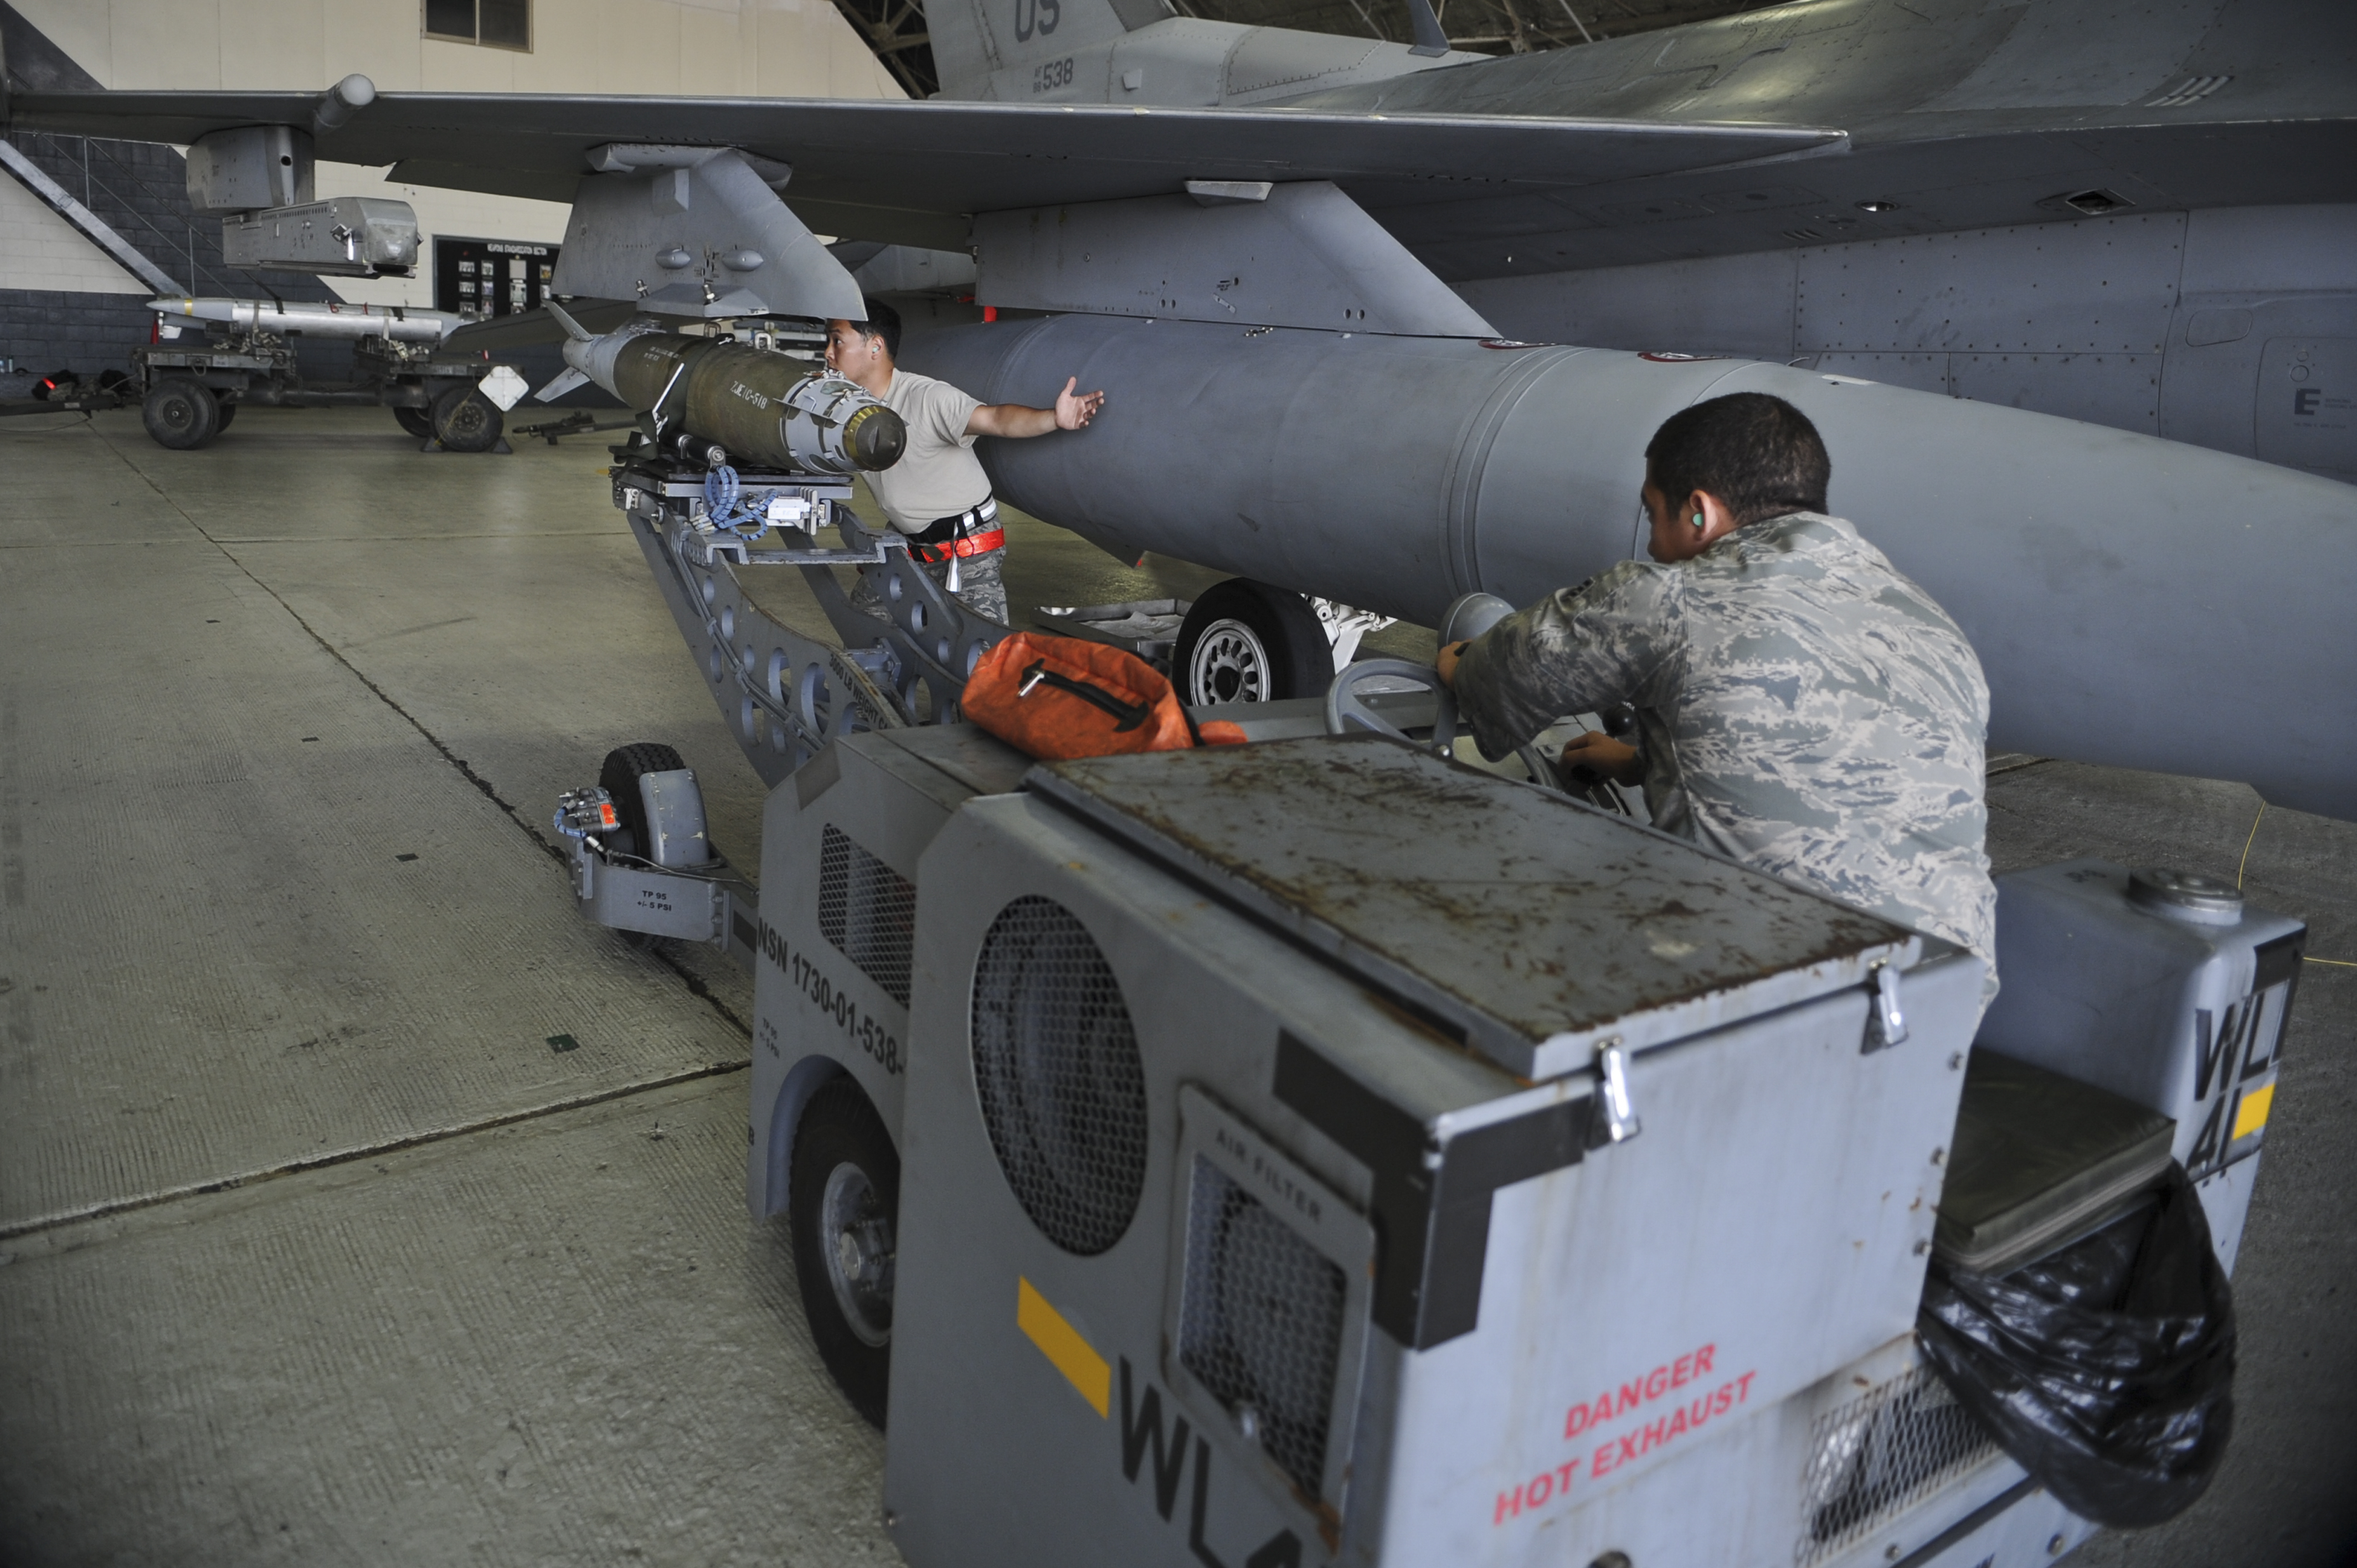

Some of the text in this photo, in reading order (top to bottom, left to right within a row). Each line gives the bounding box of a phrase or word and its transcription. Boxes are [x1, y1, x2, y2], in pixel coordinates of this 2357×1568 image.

[1043, 58, 1073, 90] 538
[2294, 388, 2321, 416] E
[844, 672, 852, 691] LB
[853, 683, 879, 723] WEIGHT
[656, 892, 667, 900] 95
[657, 903, 672, 911] PSI
[758, 916, 788, 973] NSN
[1217, 1128, 1321, 1225] AIR FILTER
[1564, 1344, 1716, 1440] DANGER
[1494, 1370, 1756, 1526] HOT EXHAUST
